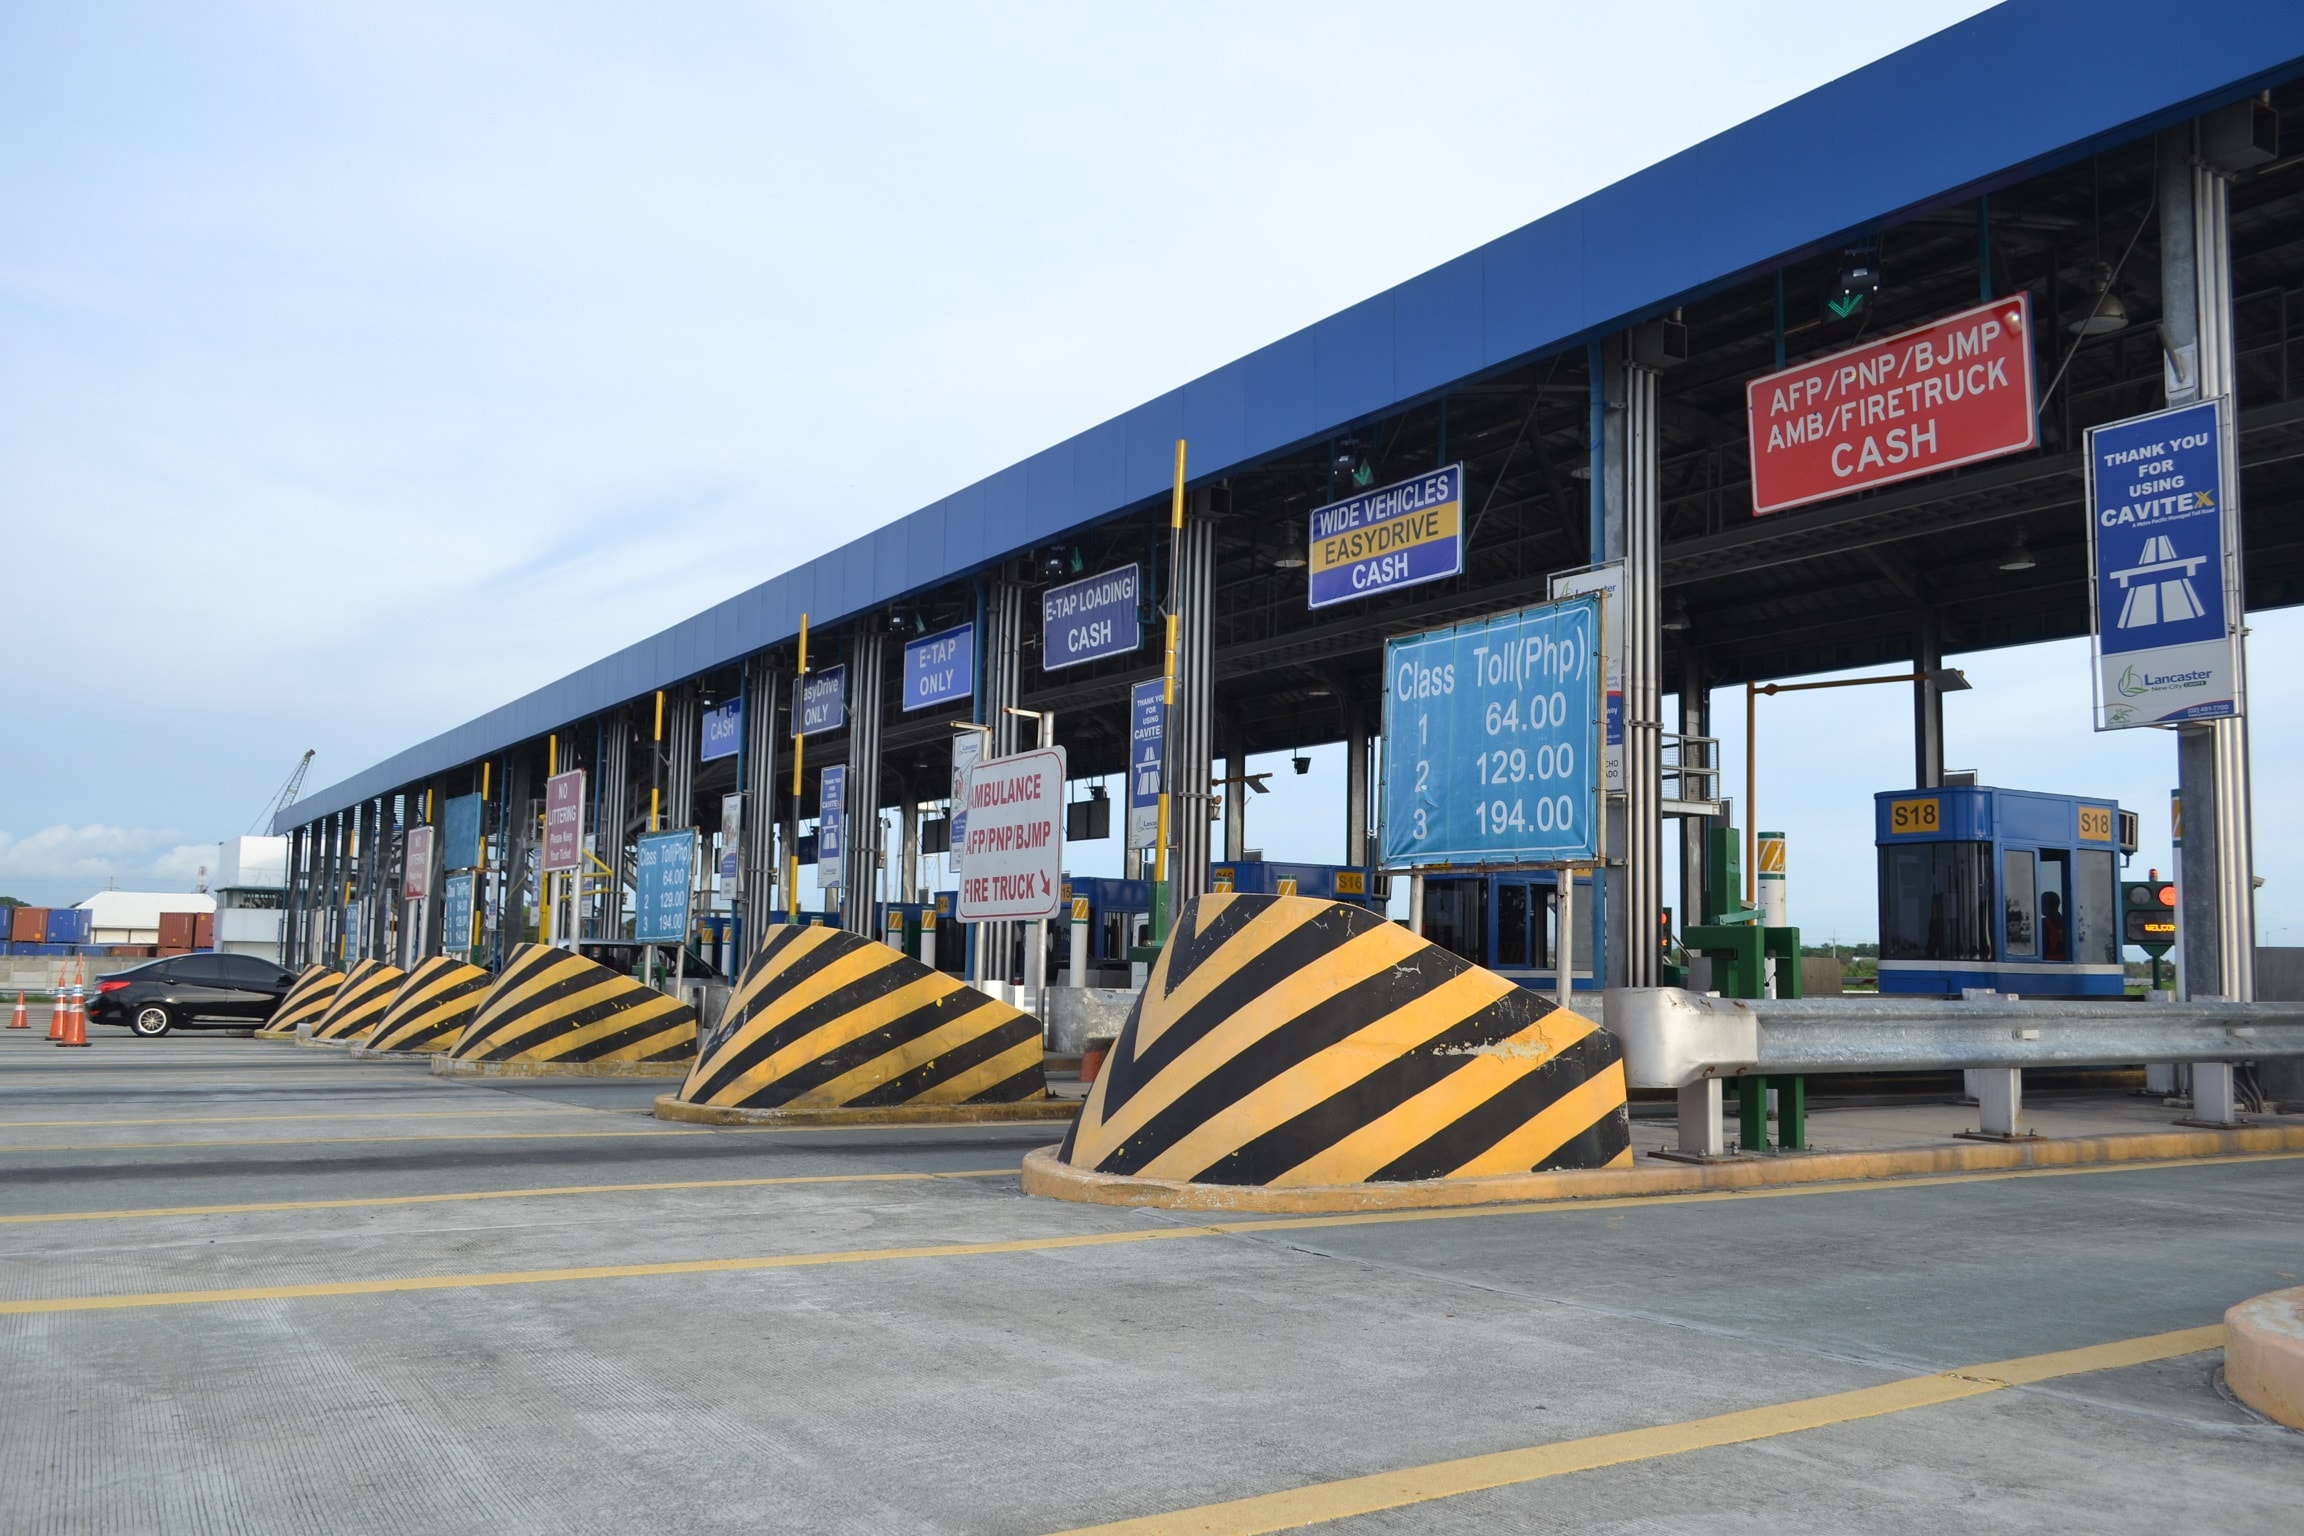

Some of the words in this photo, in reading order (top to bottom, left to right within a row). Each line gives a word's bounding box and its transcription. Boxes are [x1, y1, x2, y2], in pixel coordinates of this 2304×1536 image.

[1770, 320, 2000, 417] AFP/PNP/BJMP
[1767, 357, 2008, 453] AMB/FIRETRUCK
[1831, 419, 1937, 477] CASH
[2104, 442, 2165, 467] THANK
[2169, 432, 2208, 452] YOU
[2138, 459, 2174, 478] FOR
[2129, 475, 2185, 497] USING
[1320, 502, 1360, 536] WIDE
[1365, 475, 1449, 522] VEHICLES
[2101, 489, 2215, 527] CAVITEX
[1325, 511, 1439, 565] EASYDRIVE
[1352, 552, 1409, 589] CASH
[1045, 594, 1077, 622] E-TAP
[1080, 575, 1135, 612] LOADING/
[1068, 619, 1111, 653] CASH
[920, 639, 956, 669] E-TAP
[1397, 661, 1455, 702] Class
[1473, 626, 1585, 691] Toll(Php)
[803, 677, 838, 703] asyDrive
[920, 668, 954, 696] ONLY
[2144, 670, 2212, 686] Lancaster
[1137, 696, 1154, 707] THANK
[1155, 694, 1164, 703] YO
[1145, 706, 1156, 715] FOR
[804, 703, 829, 726] ONLY
[1142, 715, 1158, 725] USING
[1418, 712, 1428, 745] 1
[1485, 691, 1567, 736] 64.00
[710, 718, 735, 741] CASH
[1134, 725, 1161, 740] CAVITE
[1414, 760, 1429, 793] 2
[1476, 742, 1574, 785] 129.00
[558, 782, 568, 800] NO
[969, 773, 1041, 810] AMBULANCE
[548, 804, 577, 826] LITTERING
[1413, 808, 1428, 840] 3
[1475, 795, 1574, 835] 194.00
[1894, 804, 1936, 827] S18
[2081, 812, 2109, 834] S18
[966, 820, 1051, 855] AFP/PNP/BJMP
[640, 847, 657, 867] Class
[645, 872, 649, 888] 1
[663, 868, 684, 886] 64.00
[963, 877, 989, 904] FIRE
[992, 873, 1035, 902] TRUCK
[1338, 875, 1362, 890] S16
[644, 894, 649, 910] 2
[660, 890, 685, 908] 129.00
[1061, 886, 1071, 899] 15
[659, 913, 683, 931] 194.00
[2144, 924, 2175, 932] WELCOM
